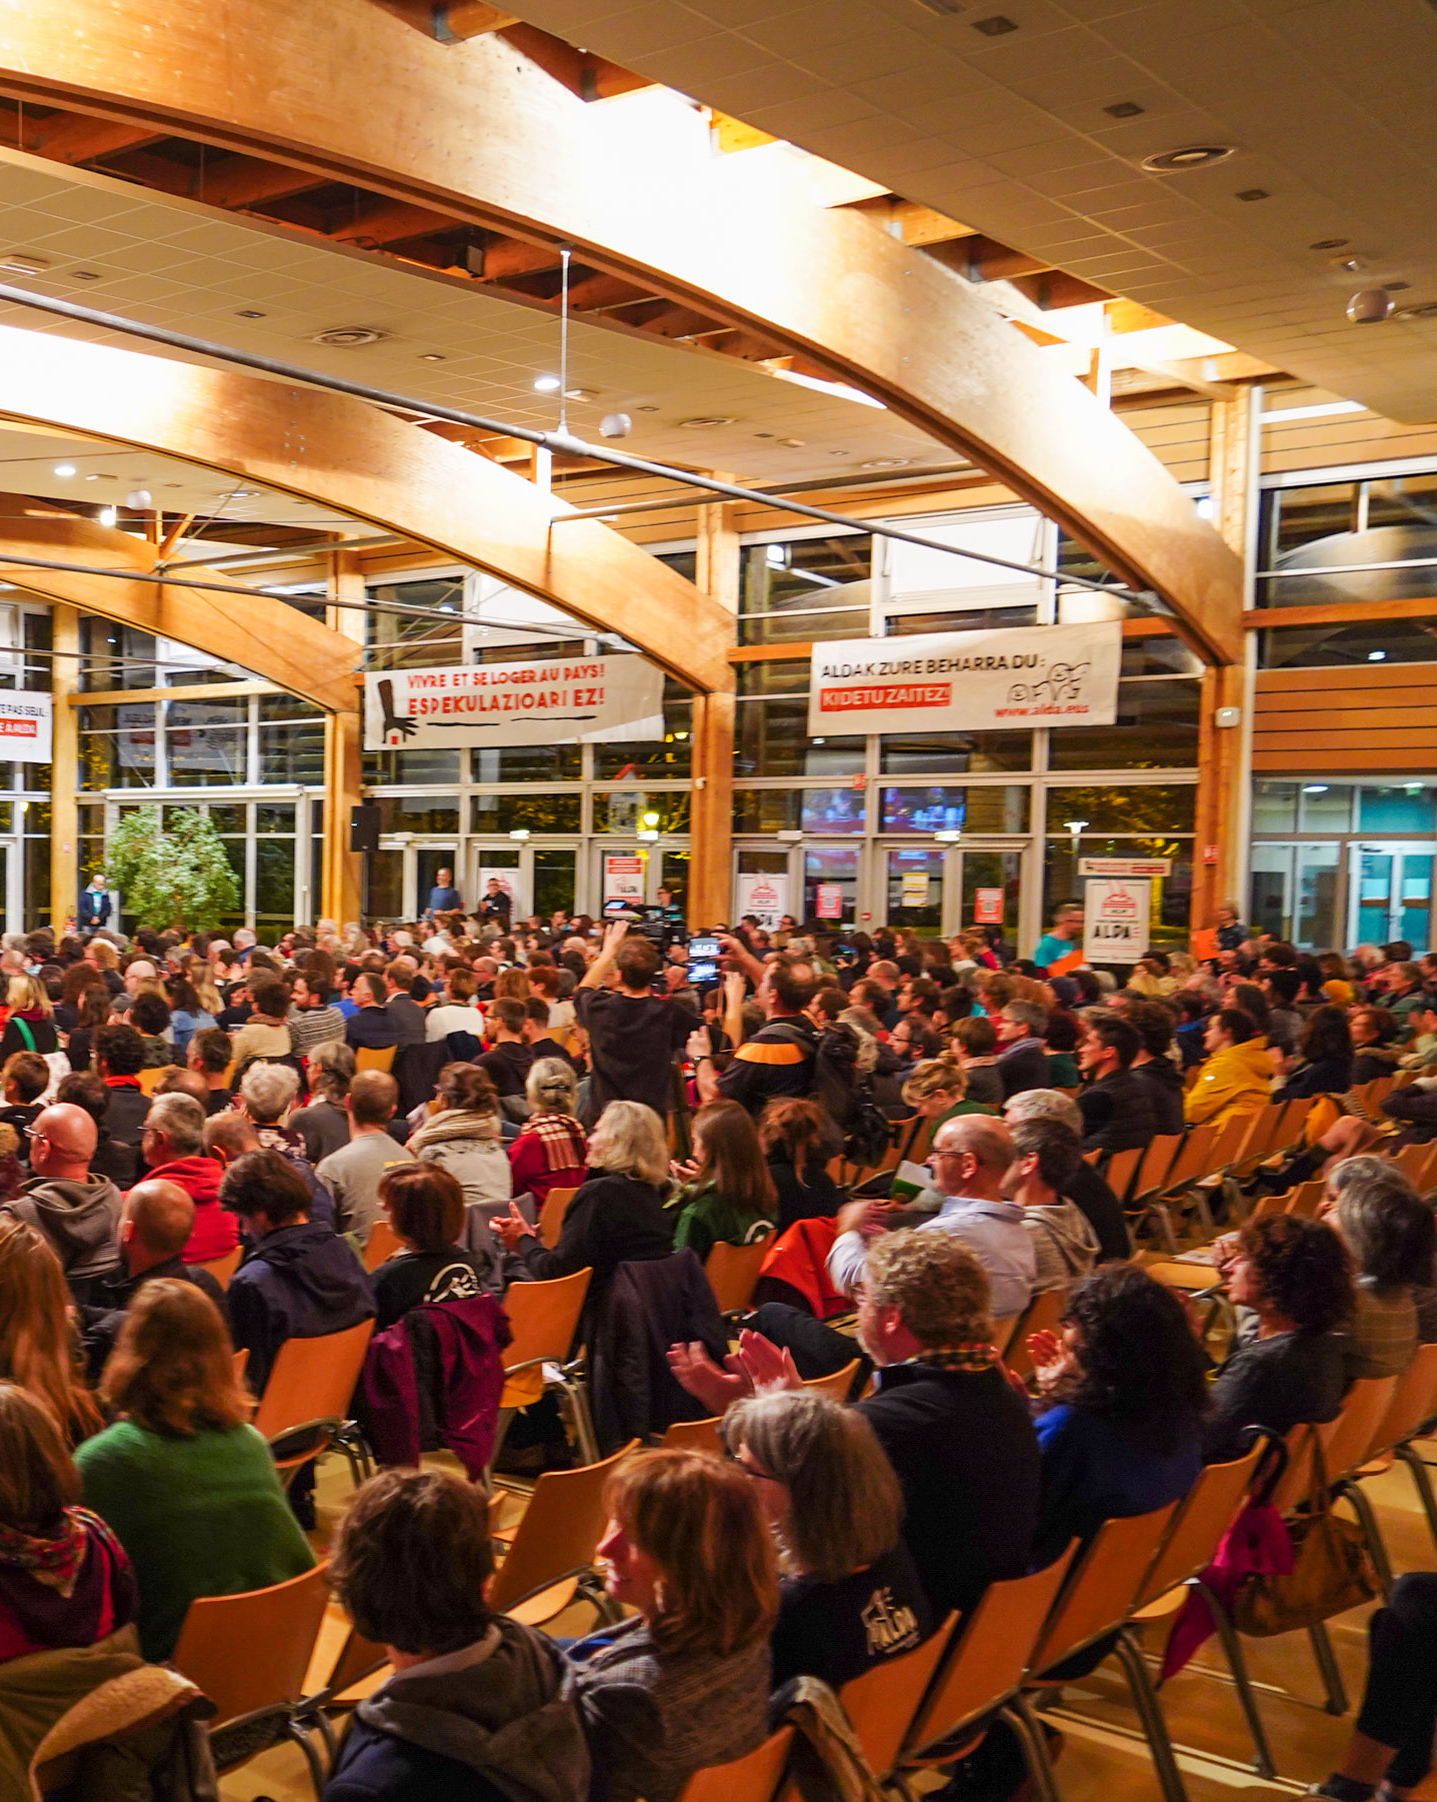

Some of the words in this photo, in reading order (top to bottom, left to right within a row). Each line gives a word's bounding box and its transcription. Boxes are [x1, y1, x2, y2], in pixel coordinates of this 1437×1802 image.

[407, 674, 446, 689] VIVRE
[453, 673, 468, 687] ET
[473, 671, 487, 686] SE
[491, 669, 536, 686] LOGER
[539, 667, 559, 683] AU
[564, 663, 605, 681] PAYS!
[821, 661, 875, 679] ALDAK
[878, 659, 922, 677] ZURE
[926, 656, 1007, 675] BEHARRA
[408, 690, 567, 715] ESPEKULAZIOARI
[573, 687, 605, 708] EZ!
[822, 687, 883, 706] KIDETU
[8, 704, 24, 715] PAS
[994, 703, 1089, 718] www.alda.eus
